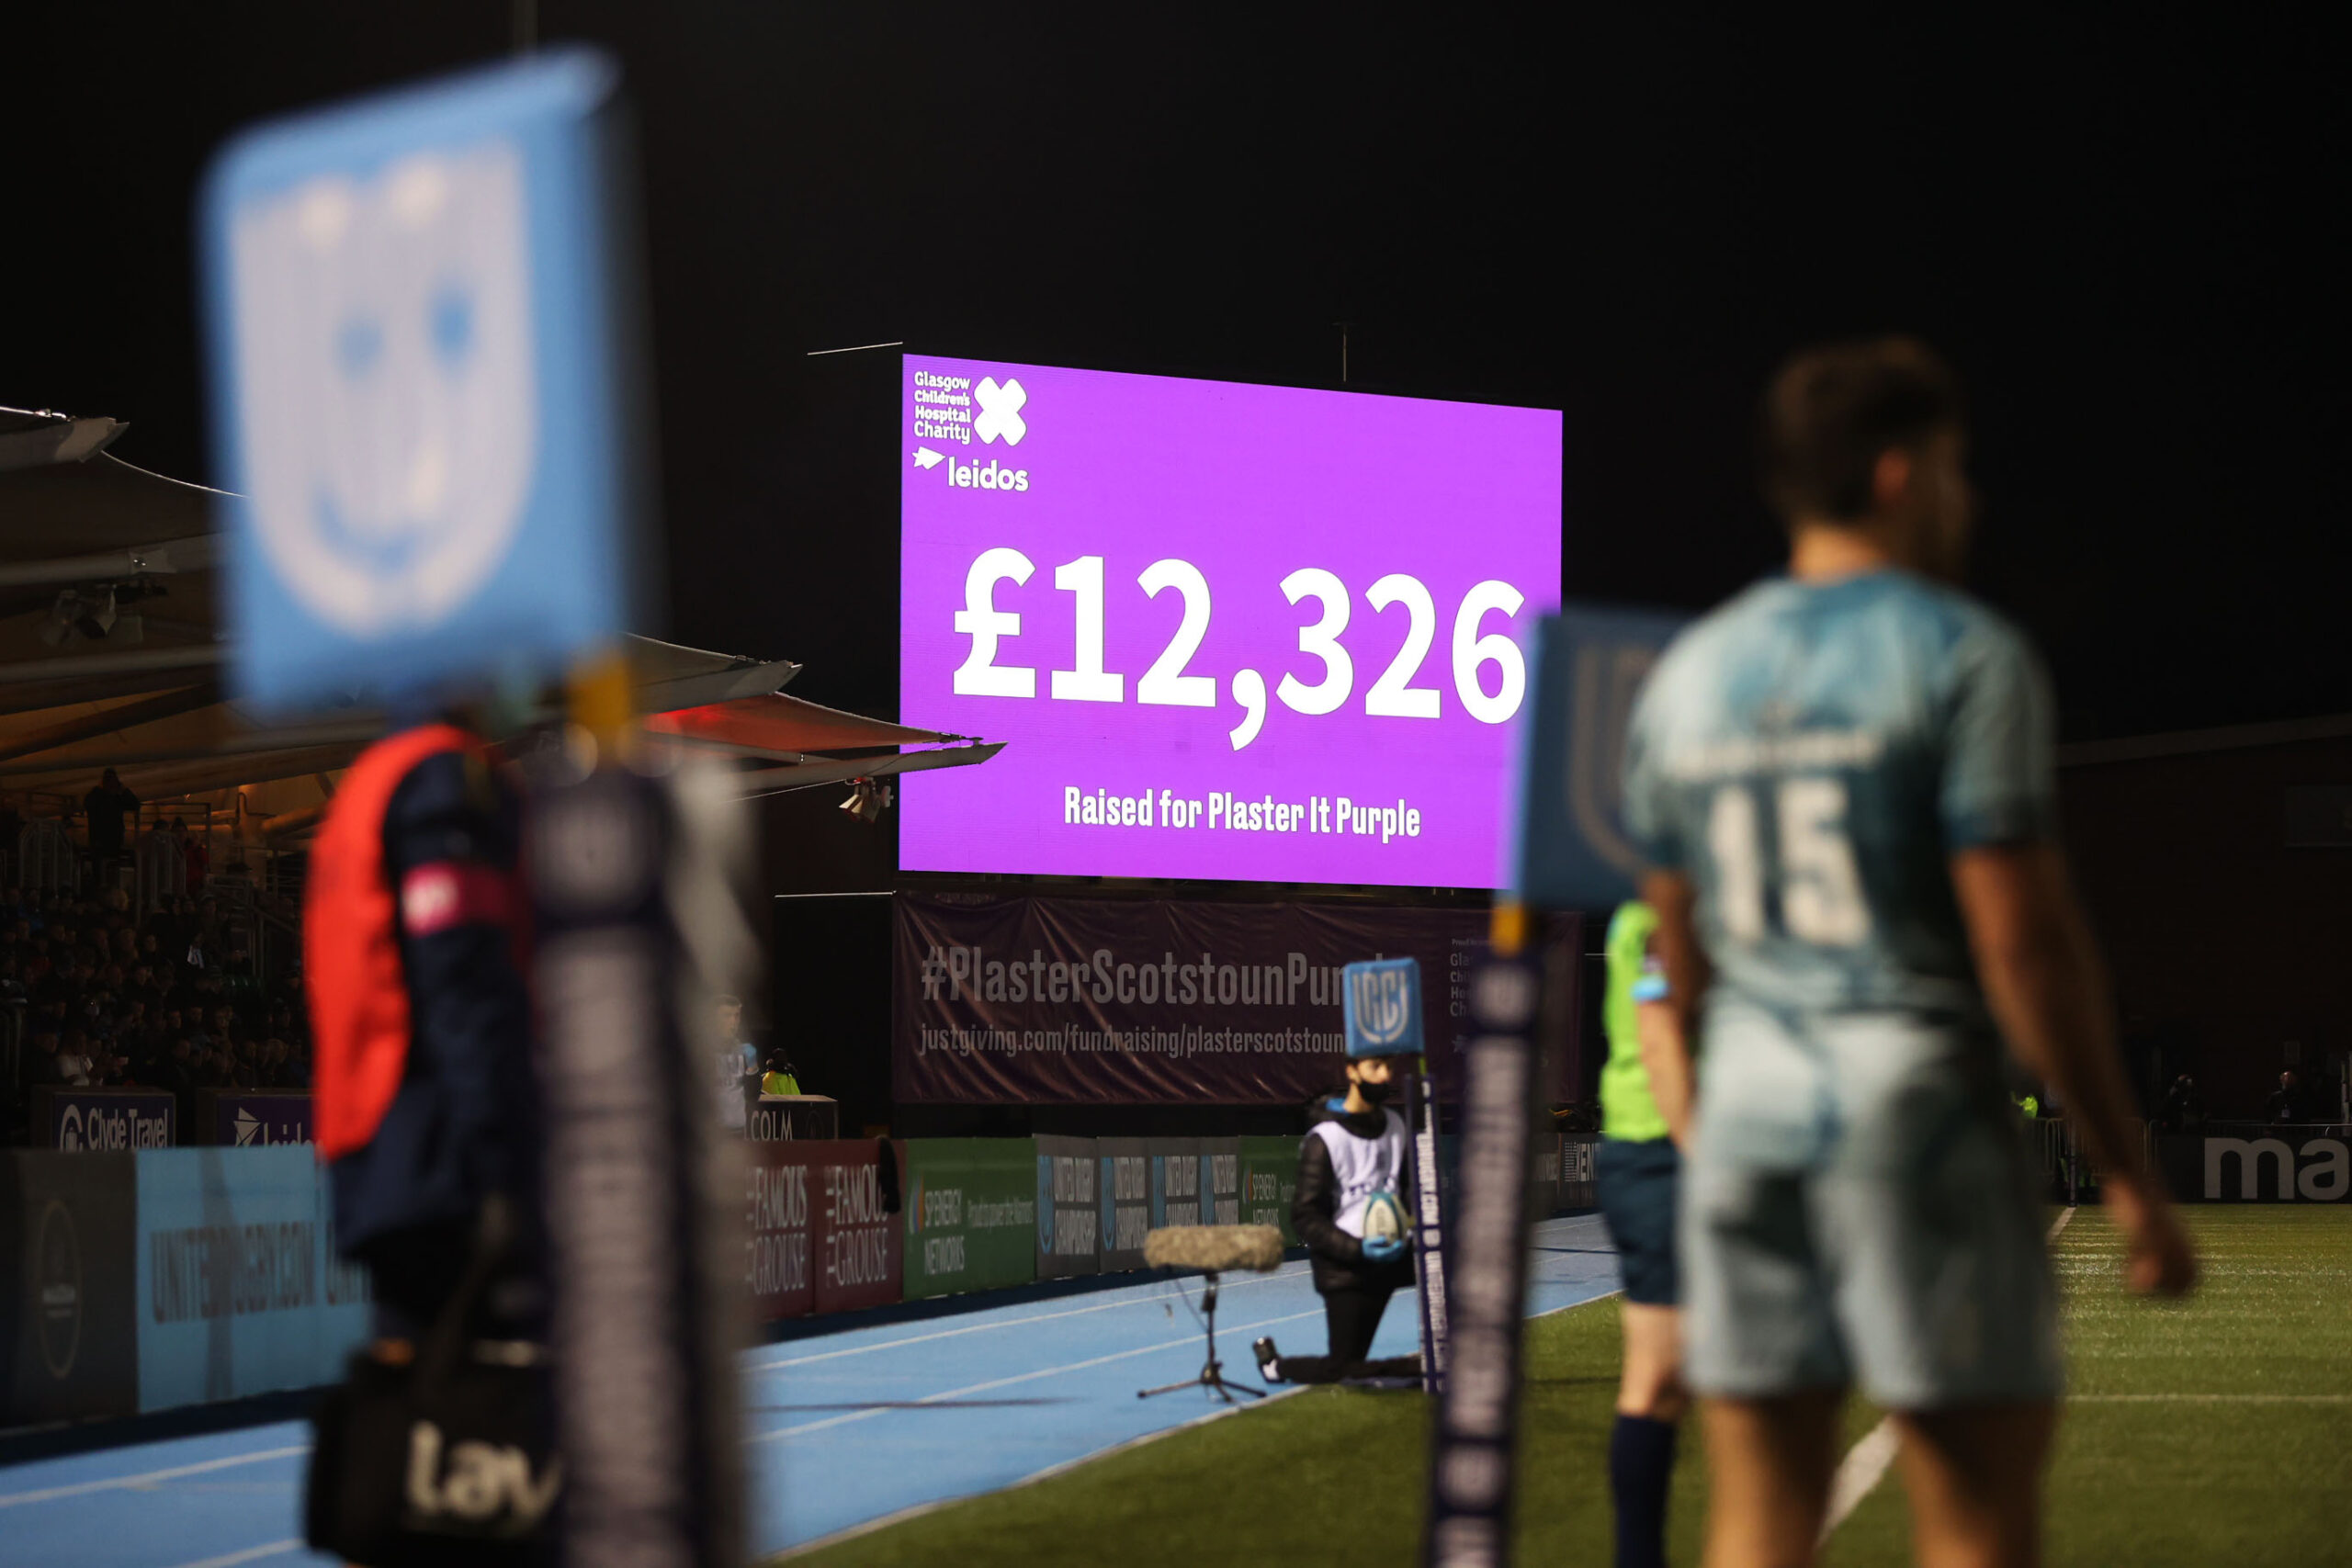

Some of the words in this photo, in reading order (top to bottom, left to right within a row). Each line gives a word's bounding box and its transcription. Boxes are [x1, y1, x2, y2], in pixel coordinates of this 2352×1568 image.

[914, 371, 970, 391] Glasgow
[914, 389, 970, 406] Children's
[914, 421, 970, 445] Charity
[915, 405, 971, 424] Hospital
[948, 456, 1029, 491] leidos
[953, 547, 1526, 751] £12,326
[1064, 785, 1152, 827] Raised
[1159, 789, 1203, 829] for
[1208, 791, 1305, 832] Plaster
[1310, 795, 1331, 833] It
[1336, 796, 1420, 844] Purple
[922, 945, 1347, 1007] #PlasterScotstounPur
[920, 1021, 1347, 1058] justgiving.com/fundraising/plasterscotstoun
[128, 1108, 168, 1149] Travel
[834, 1227, 888, 1287] GROUSE
